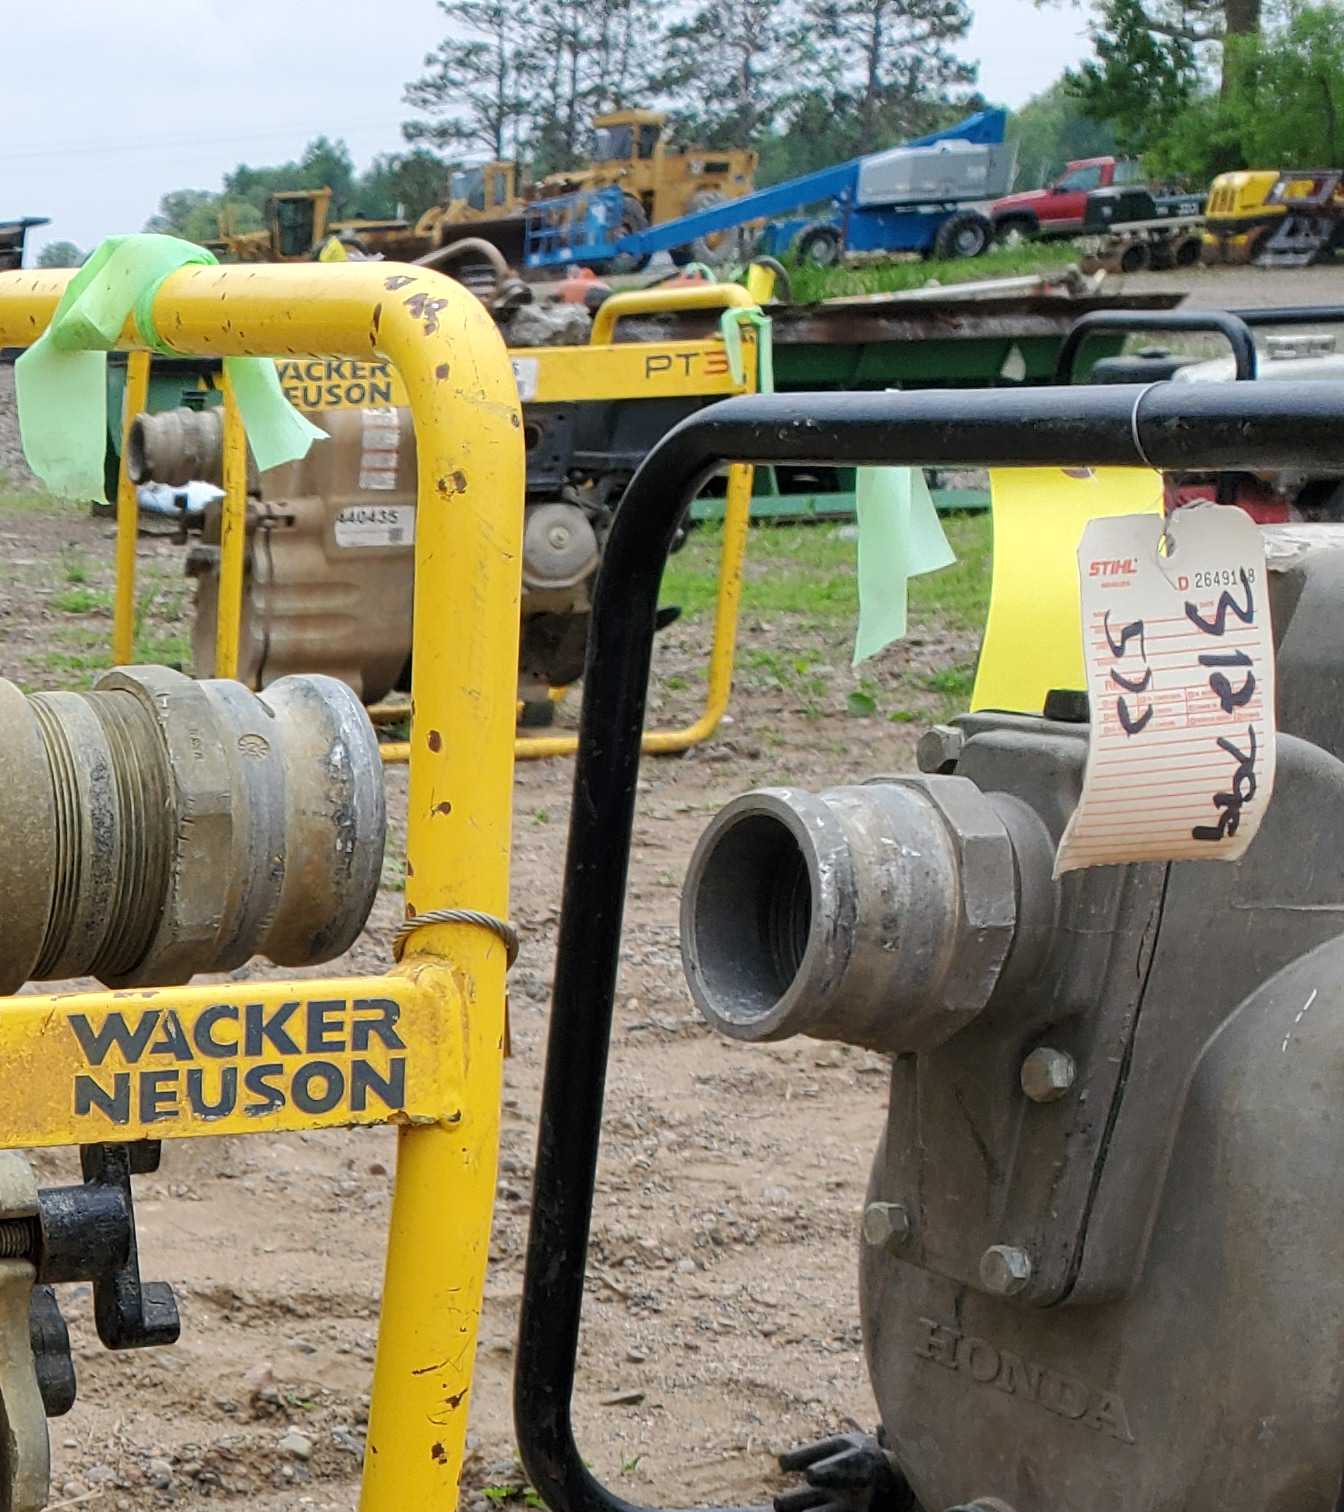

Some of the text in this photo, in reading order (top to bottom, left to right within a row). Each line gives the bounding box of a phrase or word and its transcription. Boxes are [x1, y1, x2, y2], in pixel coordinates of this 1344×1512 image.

[284, 381, 392, 407] EUSON
[1089, 558, 1139, 577] STIHL
[1195, 567, 1256, 589] 264918
[67, 998, 407, 1067] WACKER
[74, 1056, 406, 1126] NEUSON
[914, 1316, 1136, 1446] HONDA
